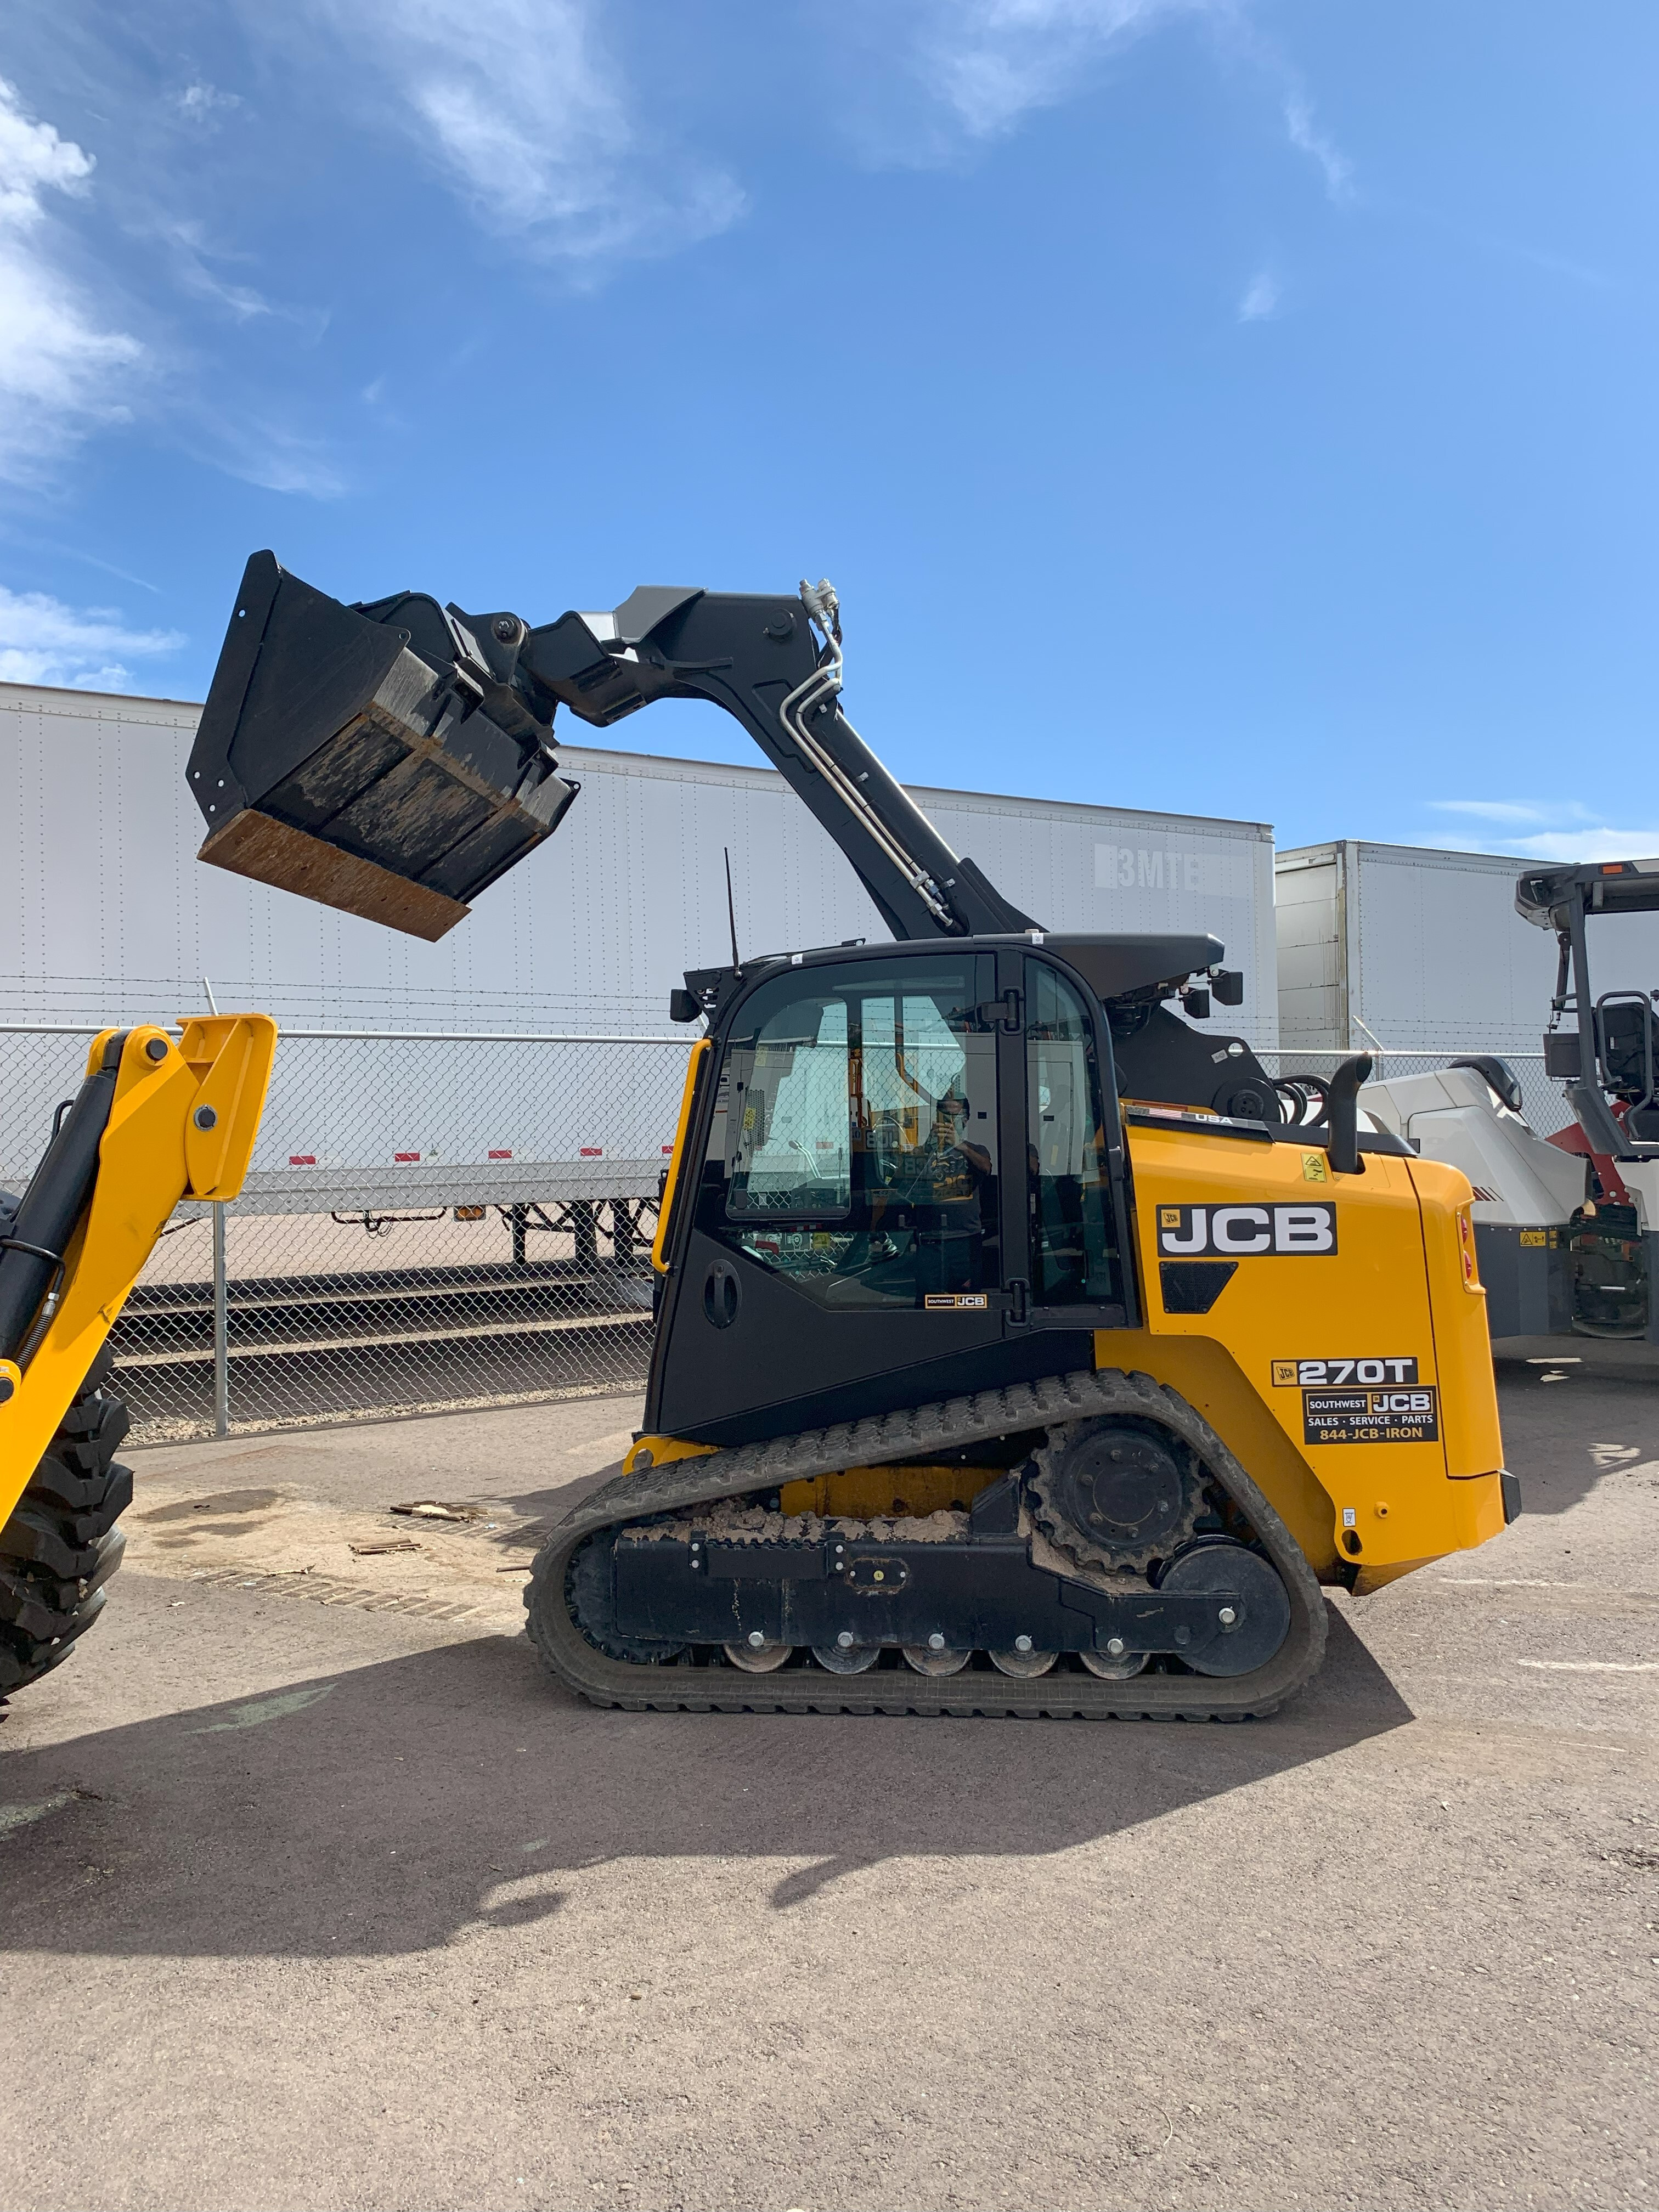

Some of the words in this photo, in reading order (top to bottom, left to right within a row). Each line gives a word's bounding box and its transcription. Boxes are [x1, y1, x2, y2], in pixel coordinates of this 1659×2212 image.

[1195, 1114, 1233, 1124] USA
[1166, 1214, 1178, 1222] JCB
[1161, 1207, 1333, 1253] JCB
[957, 1297, 984, 1306] JCB
[1280, 1368, 1293, 1379] JCB
[1299, 1359, 1413, 1384] 270T
[1310, 1400, 1366, 1409] SOUTHWEST
[1373, 1394, 1430, 1412] JCB
[1308, 1417, 1339, 1426] SALES
[1349, 1416, 1390, 1426] SERVICE
[1402, 1415, 1434, 1424] PARTS
[1320, 1427, 1423, 1440] 844-JCB-IRON
